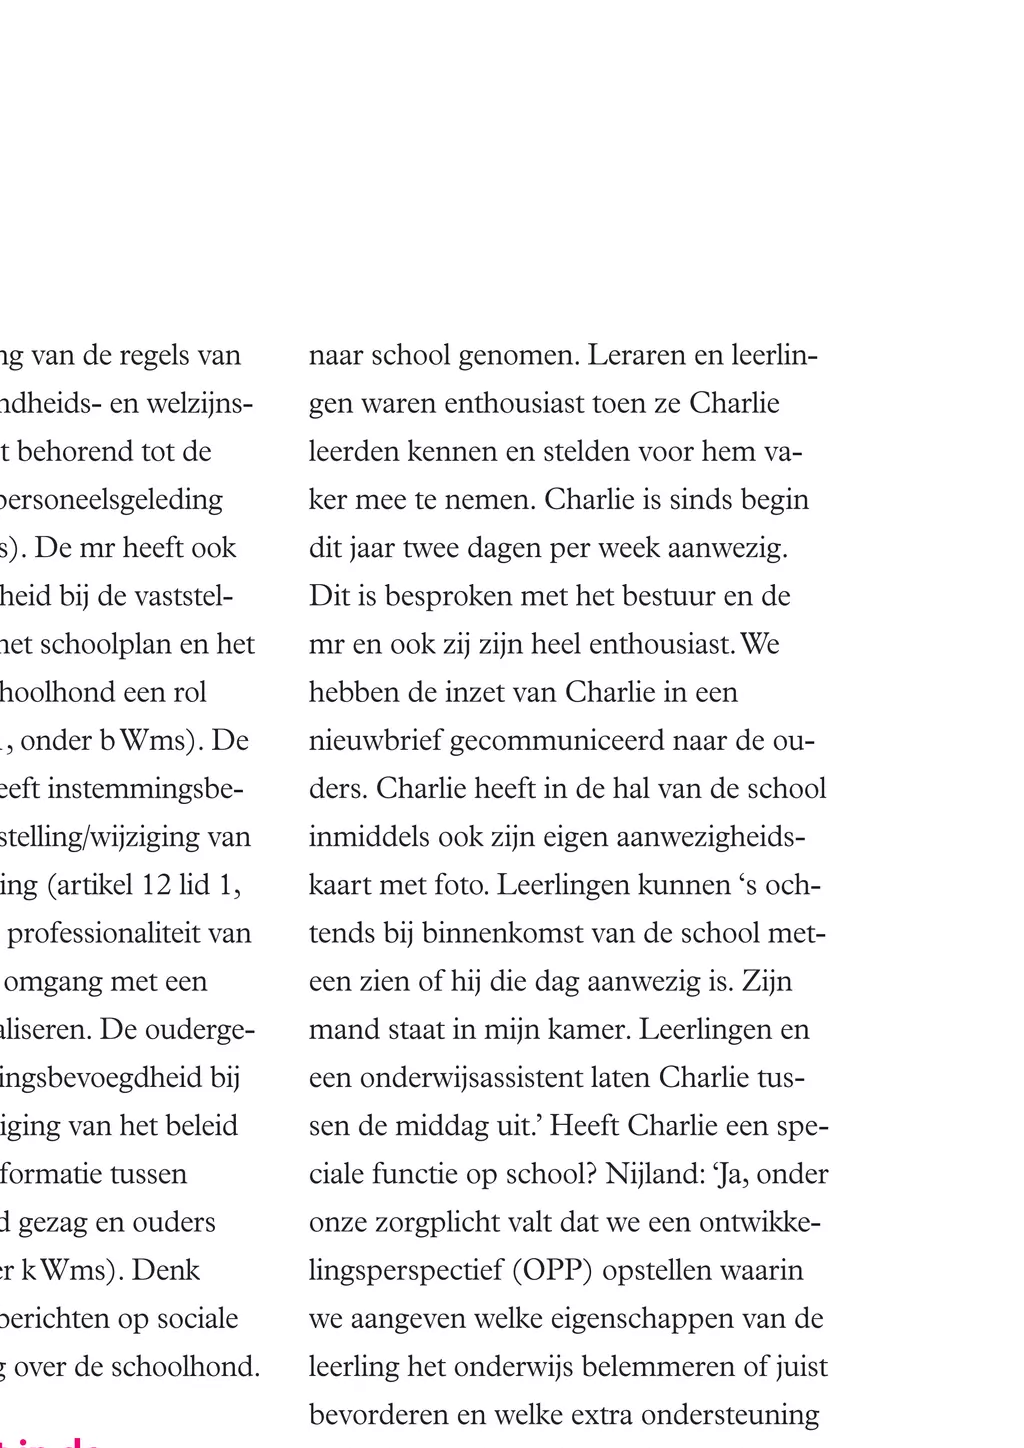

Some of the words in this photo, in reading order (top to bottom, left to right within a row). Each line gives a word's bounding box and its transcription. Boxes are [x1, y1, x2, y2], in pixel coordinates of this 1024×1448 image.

[31, 349, 75, 366] van
[83, 342, 112, 366] de
[119, 342, 190, 372] regels
[197, 349, 242, 366] van
[309, 349, 364, 366] naar
[371, 342, 451, 366] school
[458, 349, 580, 372] genomen.
[587, 342, 687, 366] Leraren
[694, 349, 724, 366] en
[731, 342, 818, 366] leerlin-
[309, 535, 343, 559] dit
[349, 535, 396, 564] jaar
[402, 539, 460, 559] twee
[467, 535, 542, 564] dagen
[549, 542, 591, 564] per
[597, 535, 661, 559] week
[668, 535, 788, 564] aanwezig.
[59, 583, 89, 612] bij
[97, 583, 127, 607] de
[134, 583, 234, 607] vaststel-
[309, 776, 368, 799] ders.
[376, 775, 467, 799] Charlie
[474, 775, 537, 799] heeft
[543, 775, 568, 799] in
[575, 776, 605, 799] de
[612, 776, 651, 799] hal
[657, 783, 703, 799] van
[710, 776, 740, 799] de
[747, 776, 827, 799] school
[47, 872, 133, 901] (artikel
[143, 873, 171, 895] 12
[179, 872, 211, 896] lid
[221, 873, 241, 900] 1,
[309, 975, 353, 992] een
[359, 968, 411, 992] zien
[418, 968, 447, 992] of
[451, 968, 481, 997] hij
[490, 968, 527, 992] die
[535, 968, 580, 998] dag
[587, 968, 702, 998] aanwezig
[708, 968, 734, 992] is.
[742, 968, 793, 997] Zijn
[210, 1064, 240, 1094] bij
[309, 1216, 368, 1233] onze
[375, 1209, 501, 1239] zorgplicht
[507, 1209, 553, 1233] valt
[560, 1209, 600, 1233] dat
[606, 1216, 641, 1233] we
[648, 1216, 692, 1233] een
[699, 1209, 821, 1233] ontwikke-
[14, 1361, 67, 1378] over
[74, 1354, 104, 1378] de
[111, 1354, 260, 1378] schoolhond.
